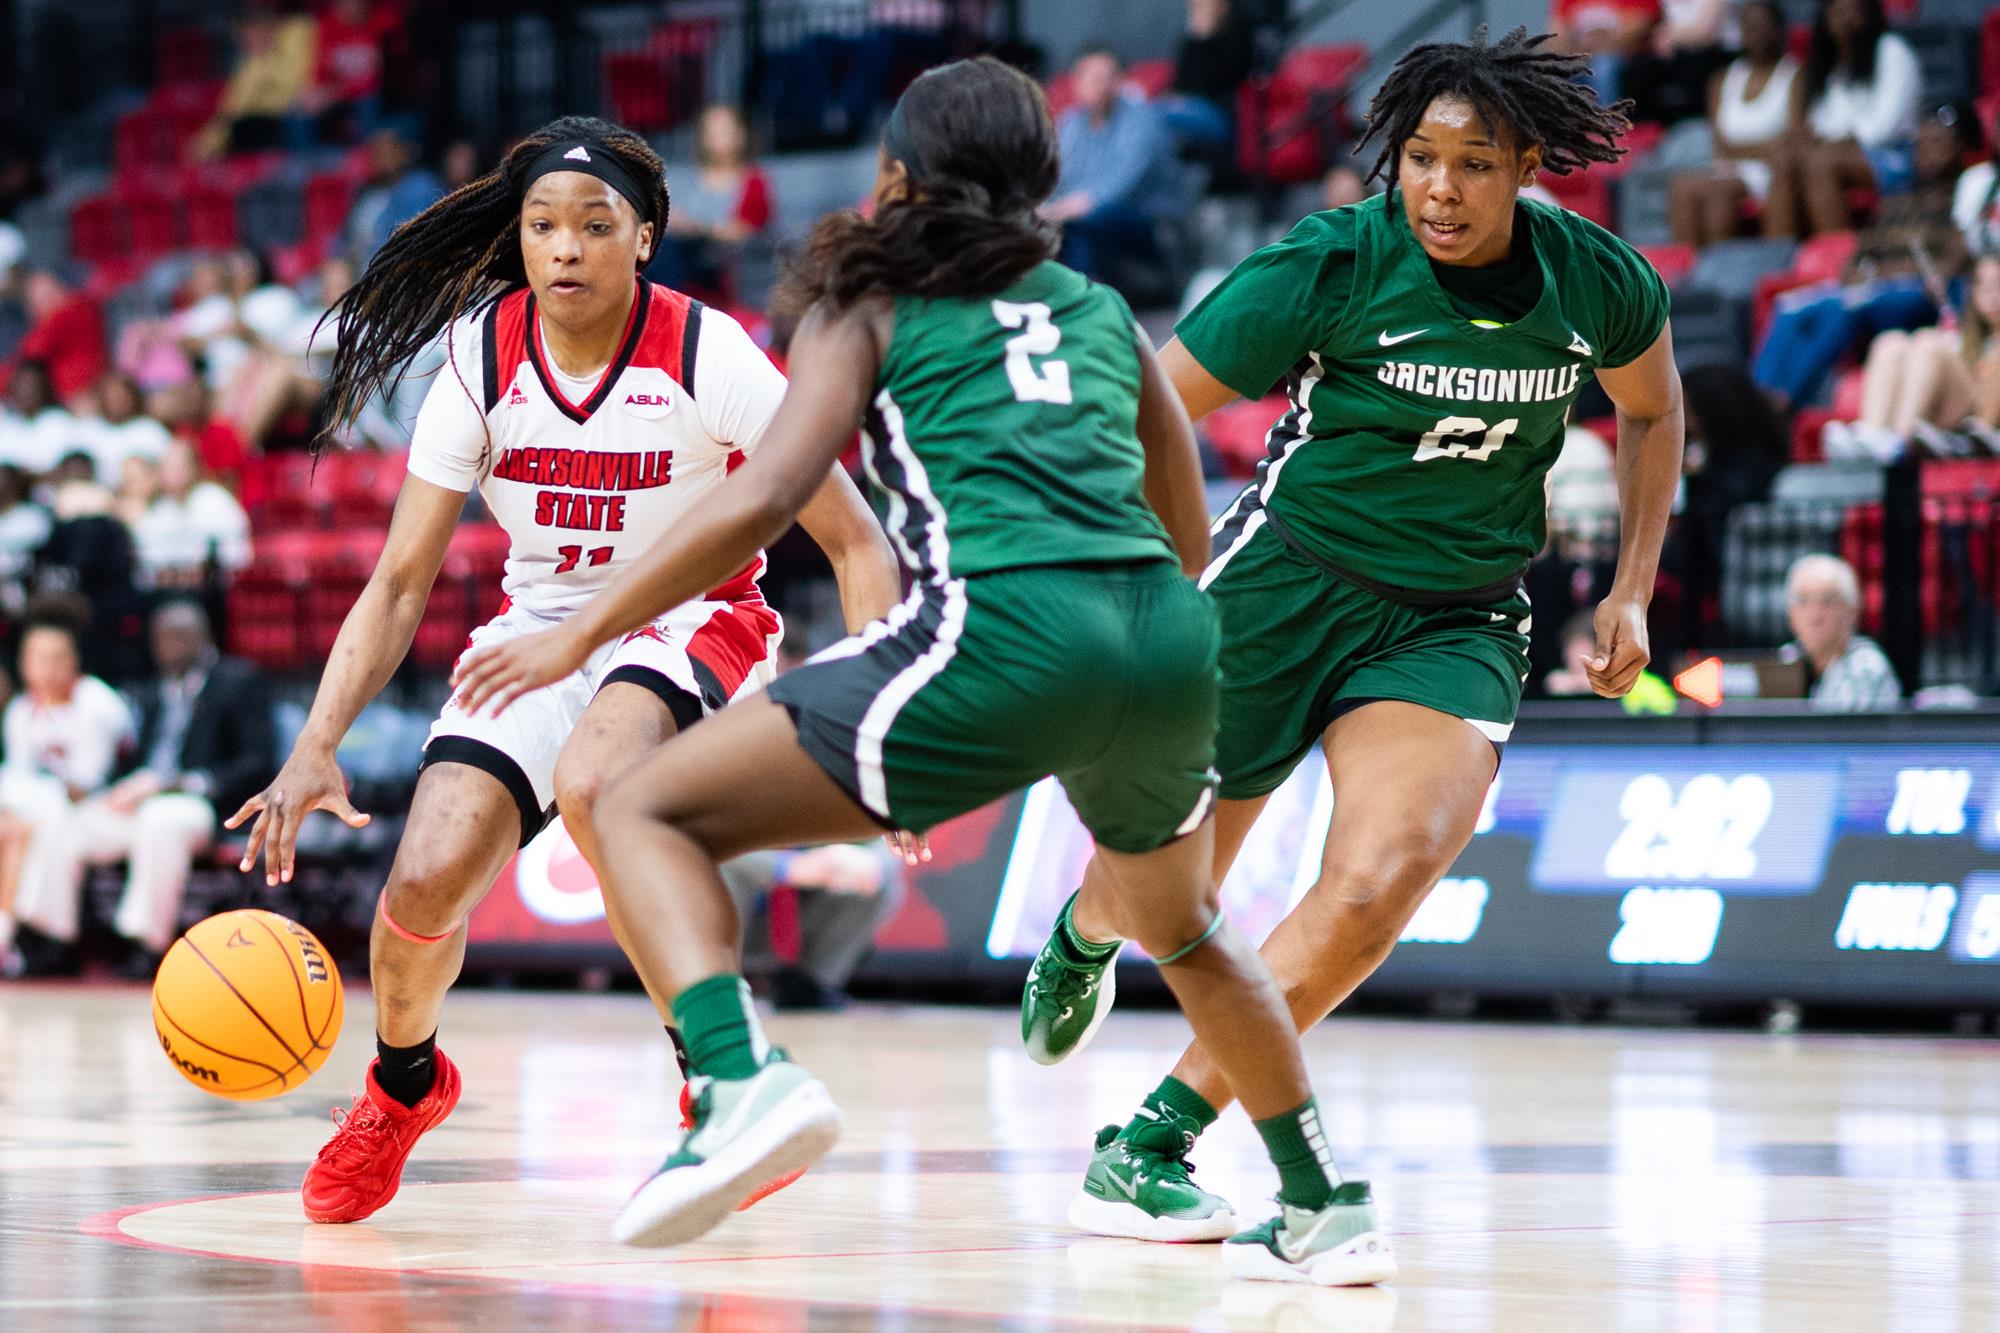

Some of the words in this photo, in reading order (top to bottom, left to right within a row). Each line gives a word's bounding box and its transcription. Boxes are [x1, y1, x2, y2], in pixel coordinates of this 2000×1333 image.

[991, 299, 1072, 405] 2
[625, 394, 670, 406] ASUN
[1377, 361, 1581, 402] JACKSONVILLE
[535, 491, 626, 531] STATE
